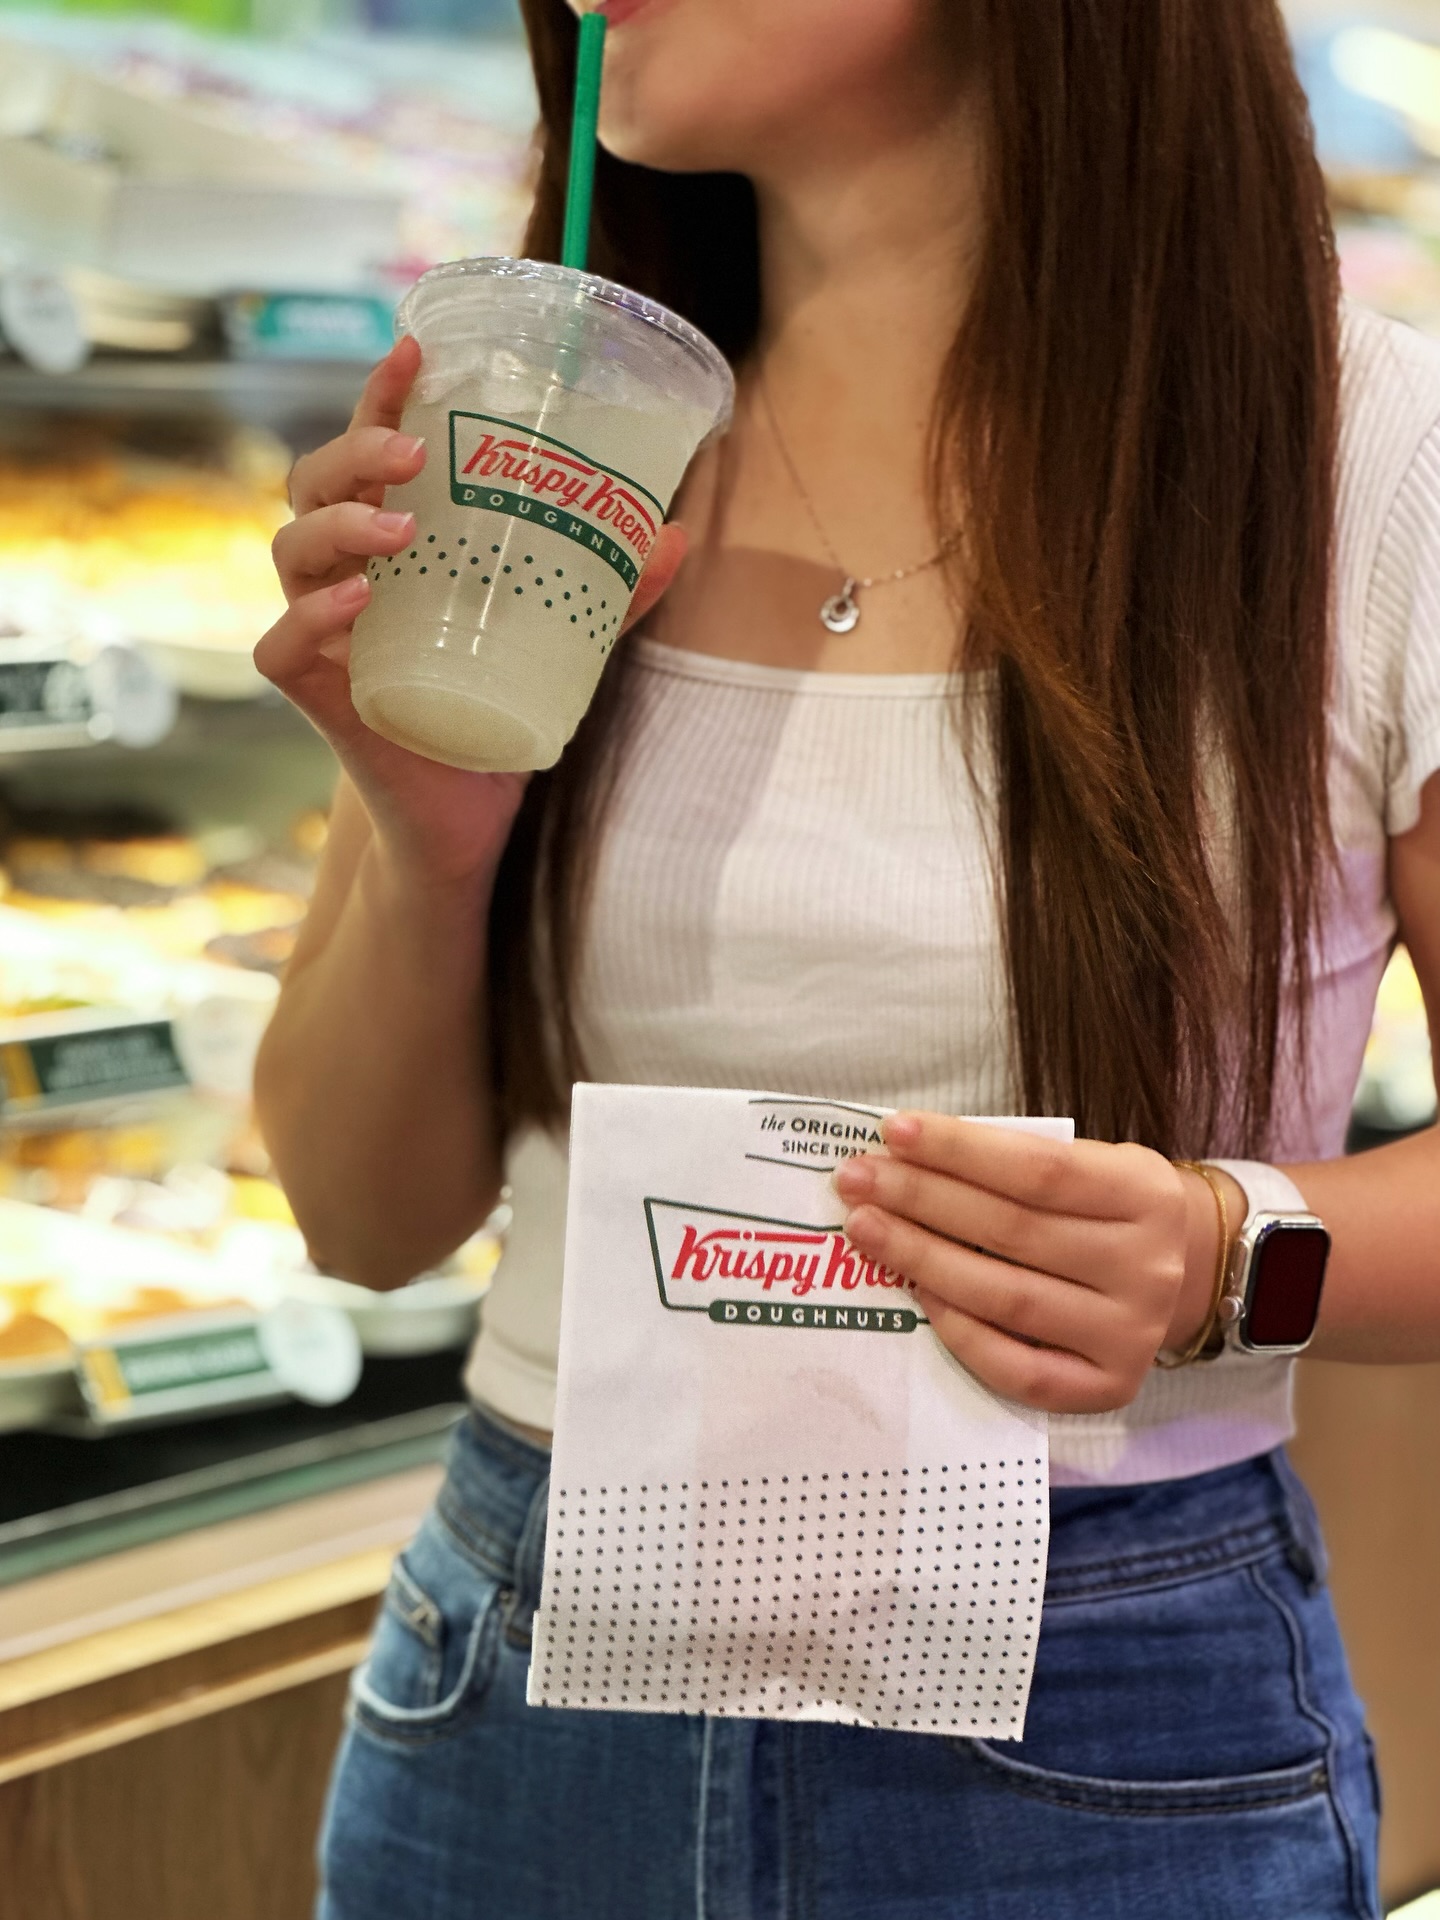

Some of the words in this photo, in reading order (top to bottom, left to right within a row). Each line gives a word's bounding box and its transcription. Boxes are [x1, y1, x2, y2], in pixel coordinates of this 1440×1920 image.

[461, 433, 598, 507] Krispy
[463, 488, 637, 585] DOUGHNUTS
[759, 1113, 786, 1132] the
[790, 1116, 887, 1145] ORIGINA
[782, 1139, 831, 1156] SINCE
[671, 1224, 829, 1297] Krispy
[724, 1303, 904, 1329] DOUGHNUTS
